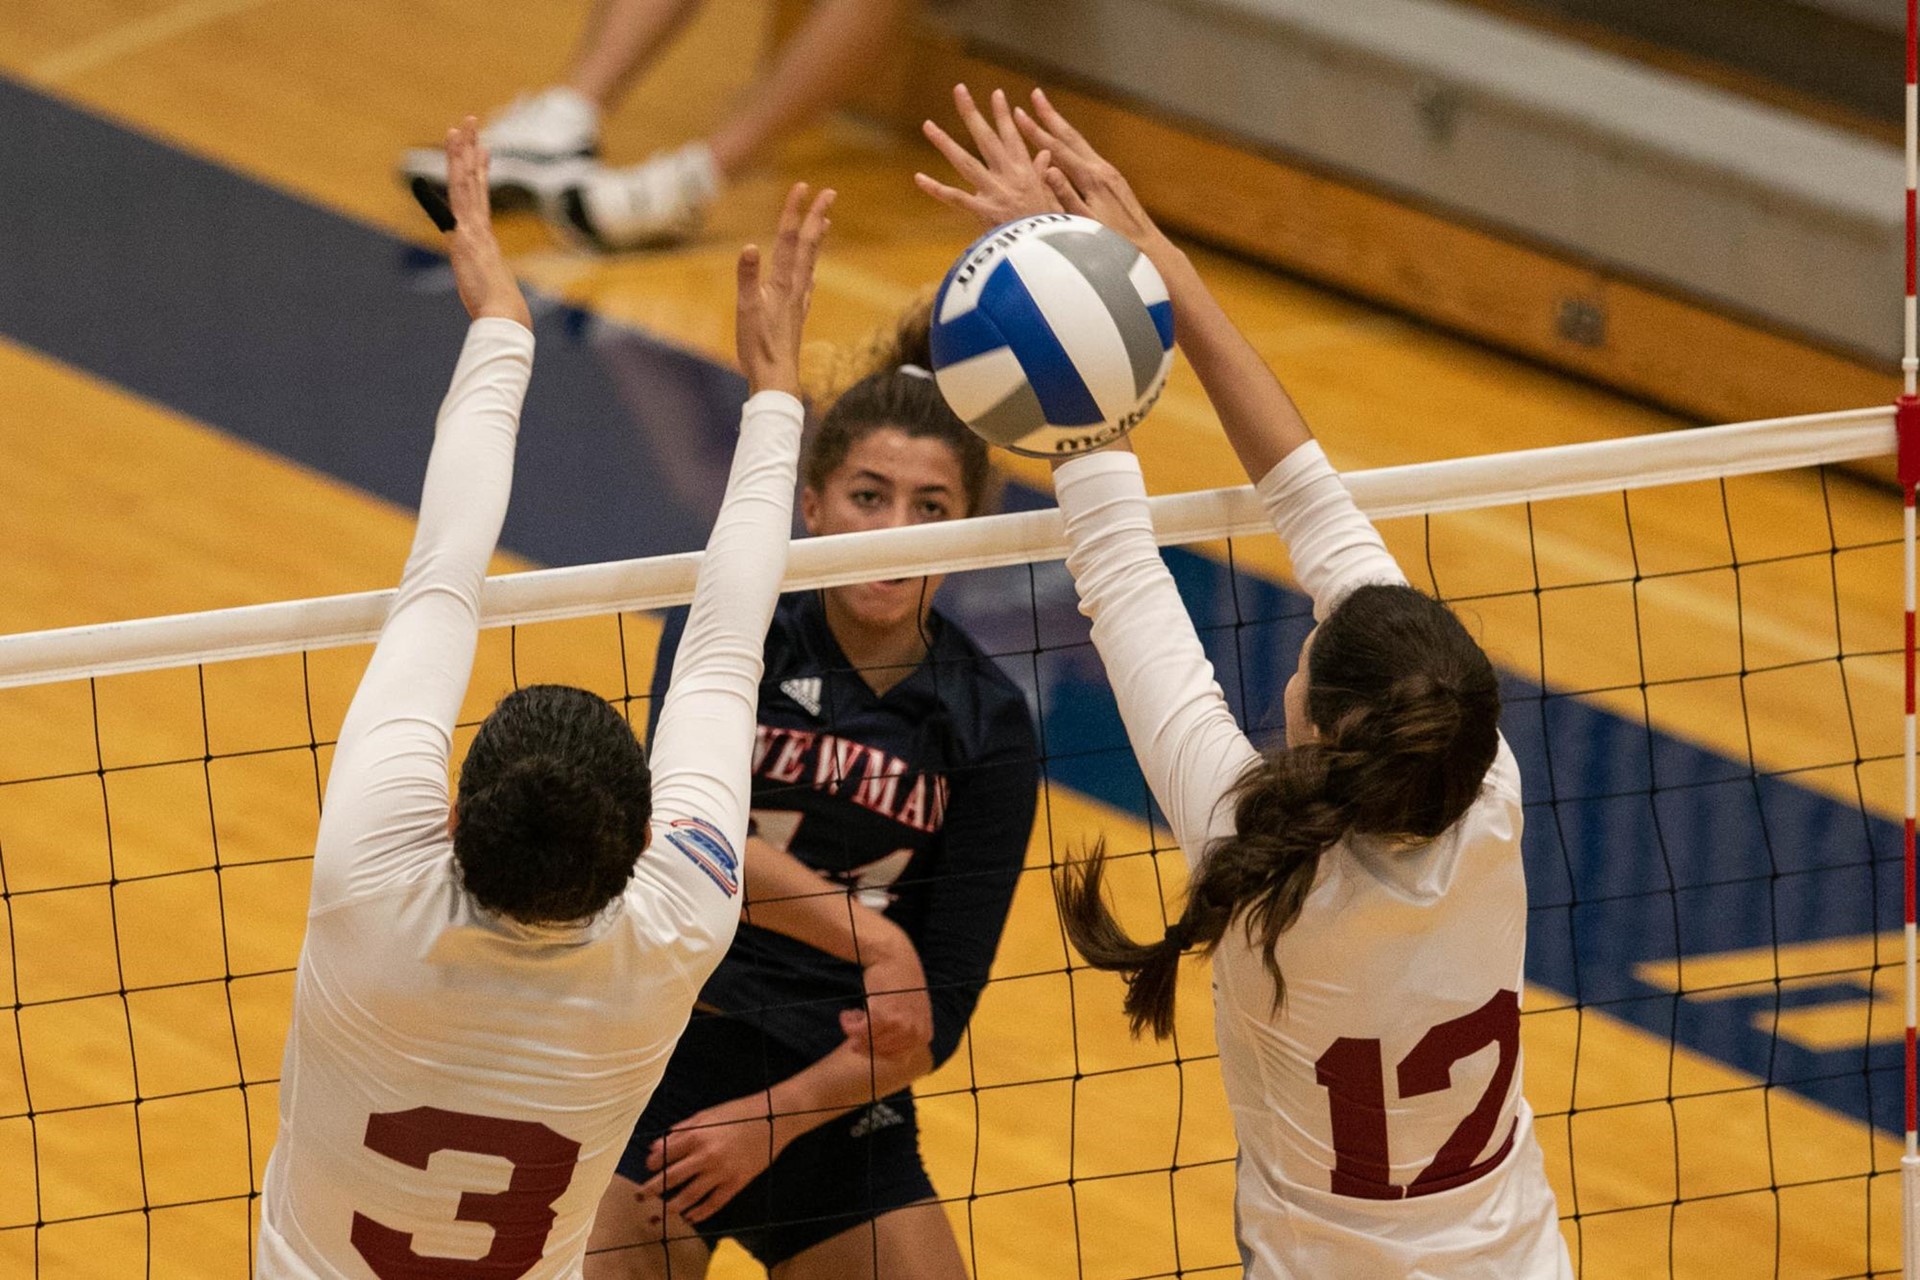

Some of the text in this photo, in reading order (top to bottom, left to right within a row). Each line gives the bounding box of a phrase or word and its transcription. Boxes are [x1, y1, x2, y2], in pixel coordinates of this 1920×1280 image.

[1056, 379, 1166, 452] molte
[1315, 988, 1521, 1200] 12
[350, 1105, 582, 1280] 3
